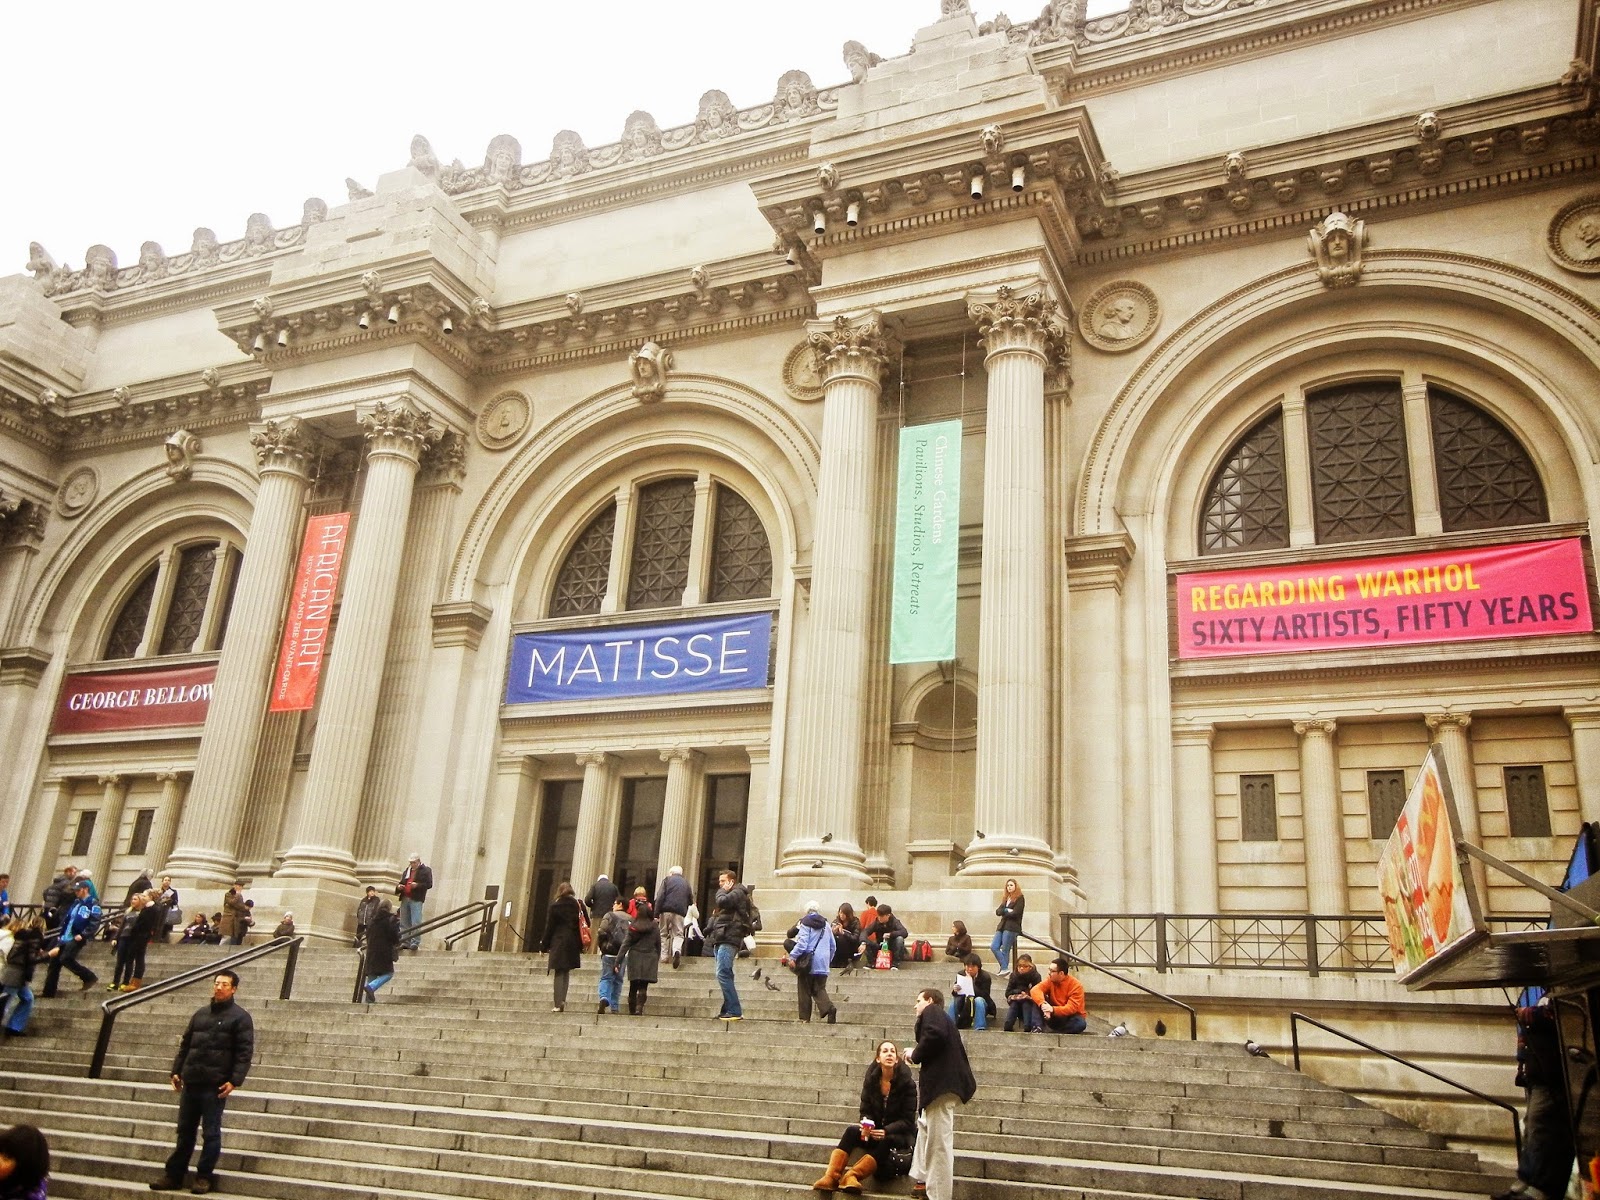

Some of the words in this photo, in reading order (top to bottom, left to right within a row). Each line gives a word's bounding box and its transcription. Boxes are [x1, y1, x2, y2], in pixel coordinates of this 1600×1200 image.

[913, 439, 928, 499] Pavilions,
[934, 435, 947, 486] Chinese
[911, 504, 926, 556] Studios,
[932, 490, 946, 544] Gardens
[301, 578, 310, 599] YORK
[306, 555, 314, 575] NEW
[306, 525, 343, 620] AFRICAN
[909, 562, 924, 615] Retreats
[1191, 575, 1345, 612] REGARDING
[1355, 563, 1480, 599] WARHOL
[292, 621, 301, 638] THE
[297, 601, 305, 619] AND
[1192, 616, 1265, 646] SIXTY
[1272, 608, 1389, 640] ARTISTS,
[1397, 600, 1472, 632] FIFTY
[1480, 592, 1579, 626] YEARS
[279, 640, 297, 700] AVANT-GARDE
[298, 628, 324, 671] ART
[528, 631, 751, 687] MATISSE
[69, 690, 141, 711] GEORGE
